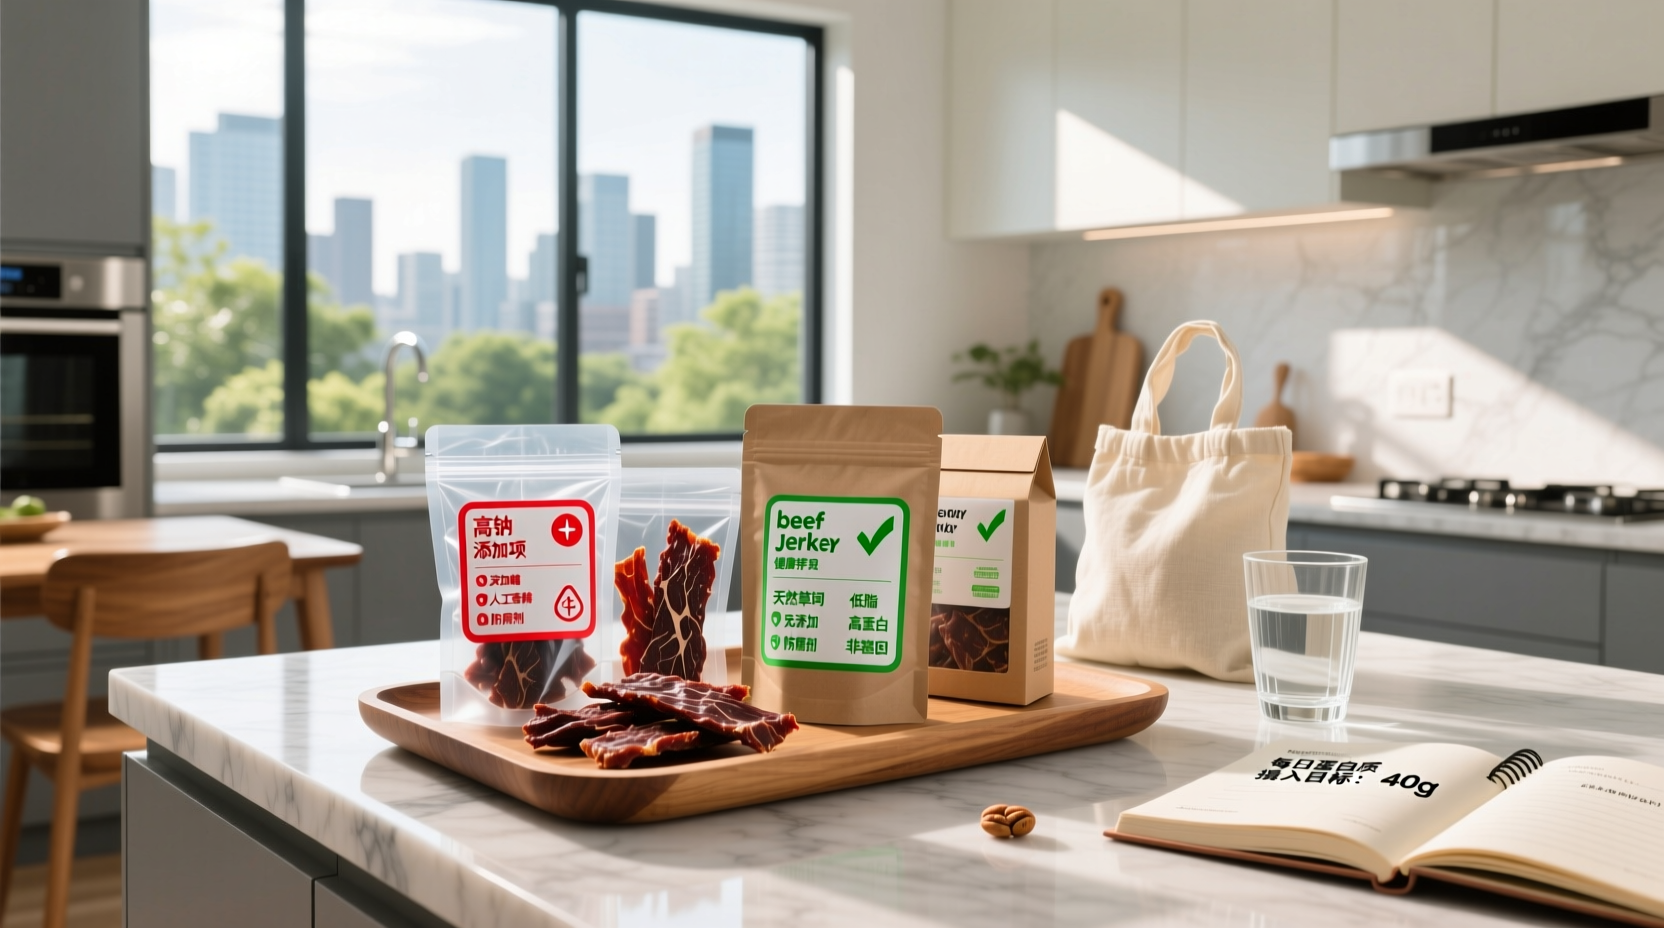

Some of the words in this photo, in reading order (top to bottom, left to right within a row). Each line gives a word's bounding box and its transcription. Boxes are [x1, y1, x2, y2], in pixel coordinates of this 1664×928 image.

[473, 515, 513, 538] 高钠
[776, 509, 826, 530] beef
[473, 540, 527, 559] 添加项
[775, 532, 841, 553] Jerkey
[849, 592, 879, 609] 低脂
[1380, 772, 1440, 799] 40g
